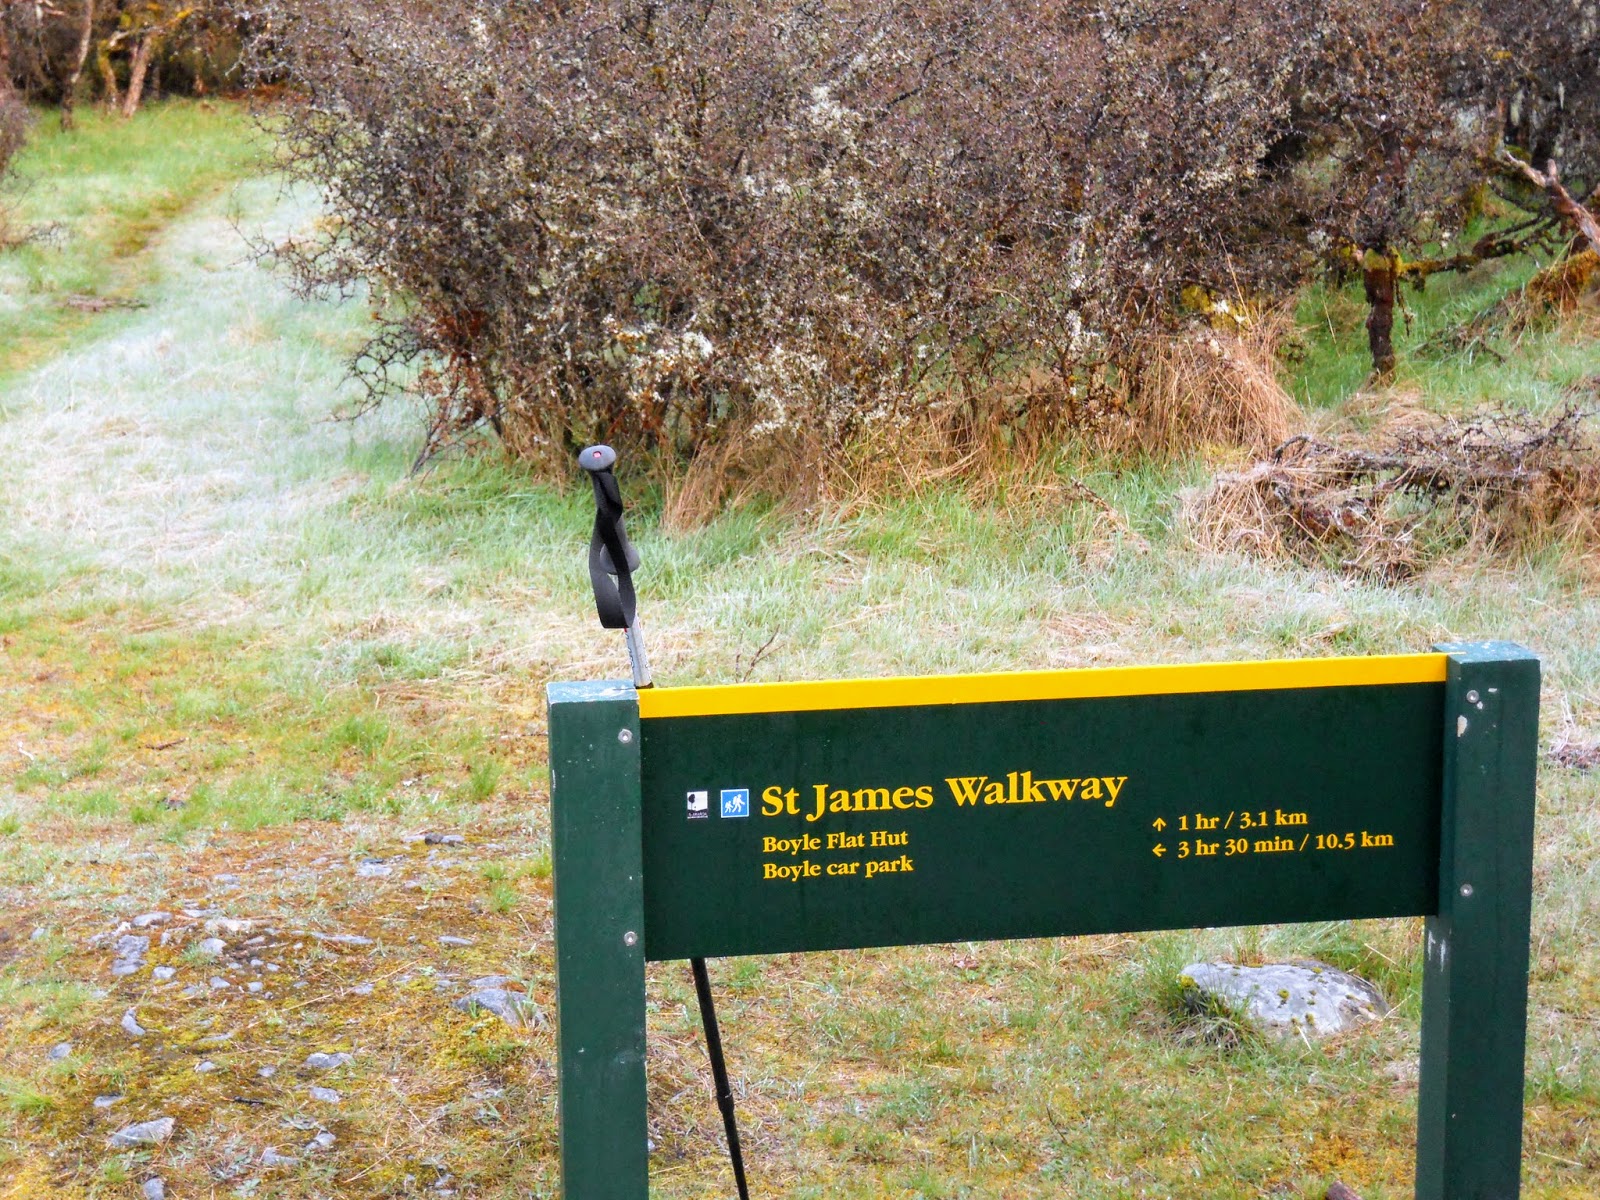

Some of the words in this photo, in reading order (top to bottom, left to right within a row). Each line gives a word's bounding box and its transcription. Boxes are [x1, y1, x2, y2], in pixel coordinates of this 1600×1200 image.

[762, 785, 801, 817] St
[805, 784, 934, 822] James
[945, 770, 1128, 808] Walkway
[1178, 815, 1189, 831] 1
[1195, 813, 1220, 830] hr
[1239, 811, 1269, 830] 3.1
[1275, 808, 1308, 826] km
[762, 833, 822, 856] Boyle
[826, 831, 866, 850] Flat
[870, 830, 909, 847] Hut
[1177, 841, 1190, 859] 3
[1195, 839, 1220, 856] hr
[1224, 838, 1249, 857] 30
[1253, 835, 1295, 853] min
[1315, 832, 1356, 850] 10.5
[1360, 830, 1394, 848] km
[762, 859, 822, 882] Boyle
[826, 861, 861, 876] car
[864, 854, 914, 879] park
